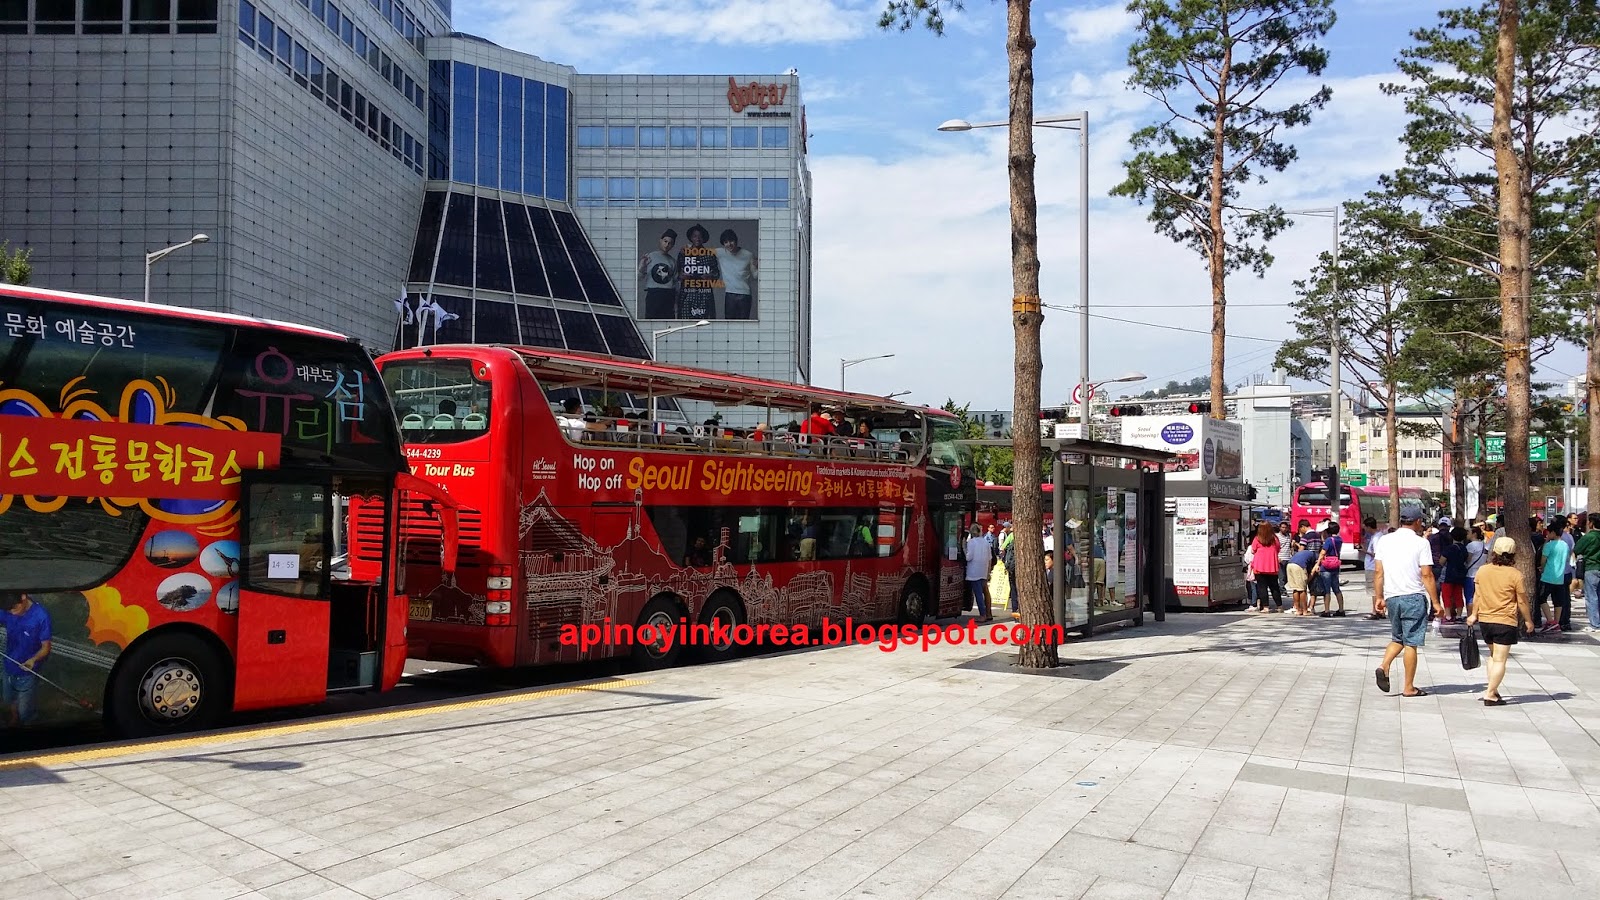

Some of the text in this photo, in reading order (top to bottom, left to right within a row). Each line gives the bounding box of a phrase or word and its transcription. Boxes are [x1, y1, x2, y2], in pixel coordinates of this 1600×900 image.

[684, 256, 700, 265] RE-
[684, 265, 710, 274] OPEN
[684, 279, 726, 288] FESTIVAL
[4, 312, 136, 349] 문화 예술공간
[296, 364, 335, 383] 대부도
[0, 432, 38, 478] 스
[573, 453, 614, 472] Hop on
[425, 463, 450, 476] Tour
[453, 463, 475, 477] Bus
[626, 456, 813, 496] Seoul Sightseeing
[578, 474, 622, 492] Hop off
[816, 477, 852, 498] 2층버스
[1548, 498, 1556, 507] P
[410, 606, 430, 617] 2300
